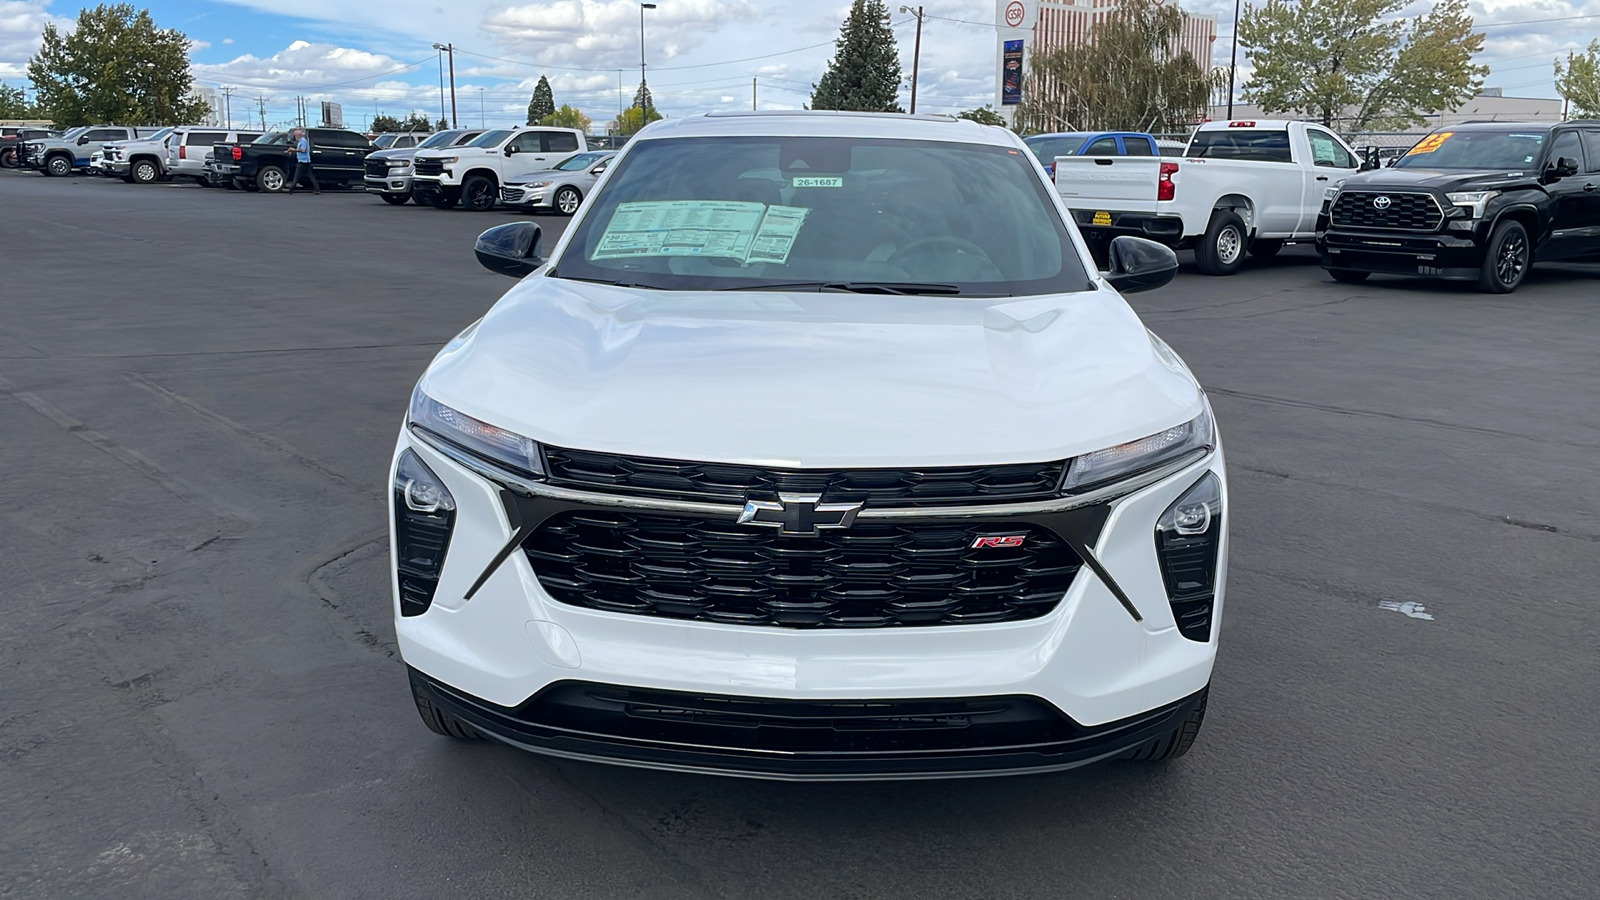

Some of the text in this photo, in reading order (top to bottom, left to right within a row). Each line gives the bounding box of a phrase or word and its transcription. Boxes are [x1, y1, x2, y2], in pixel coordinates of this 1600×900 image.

[1008, 9, 1022, 20] GSR
[1058, 171, 1151, 180] CHEVROLET
[971, 535, 1026, 549] RS
